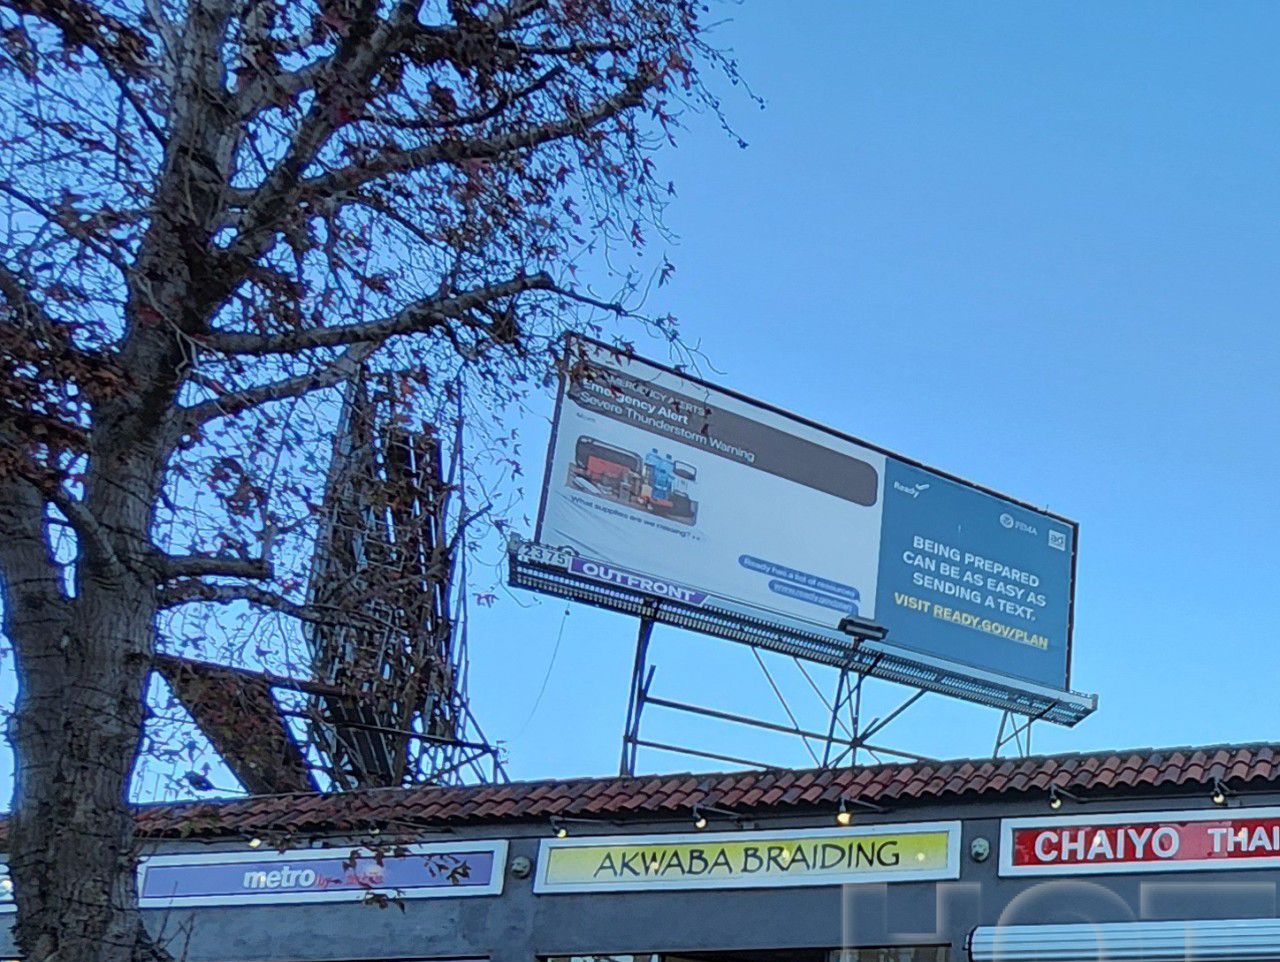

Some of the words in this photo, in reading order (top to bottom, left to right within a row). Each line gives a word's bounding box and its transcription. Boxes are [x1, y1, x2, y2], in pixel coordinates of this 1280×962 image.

[582, 379, 654, 414] Emegency
[658, 405, 689, 426] Alert
[668, 396, 706, 417] AERTS
[579, 391, 623, 414] Severe
[626, 407, 707, 445] Thunderstorm
[709, 437, 755, 463] Warning
[523, 546, 567, 566] 2375
[912, 535, 960, 561] BEING
[964, 552, 1040, 587] PREPARED
[582, 563, 696, 601] OUTFRONT
[902, 550, 936, 571] CAN
[940, 562, 960, 579] BE
[963, 569, 984, 587] AS
[987, 578, 1024, 600] EASY
[1027, 591, 1047, 607] AS
[912, 572, 981, 604] SENDING
[984, 595, 995, 609] A
[998, 599, 1036, 621] TEXT.
[894, 592, 931, 613] VISIT
[933, 604, 1048, 649] READY.GOV/PLAN
[593, 847, 733, 878] AKWABA
[740, 840, 900, 875] BRAIDING
[1034, 826, 1180, 862] CHAIYO
[1207, 825, 1280, 853] THAI
[243, 866, 315, 889] metro
